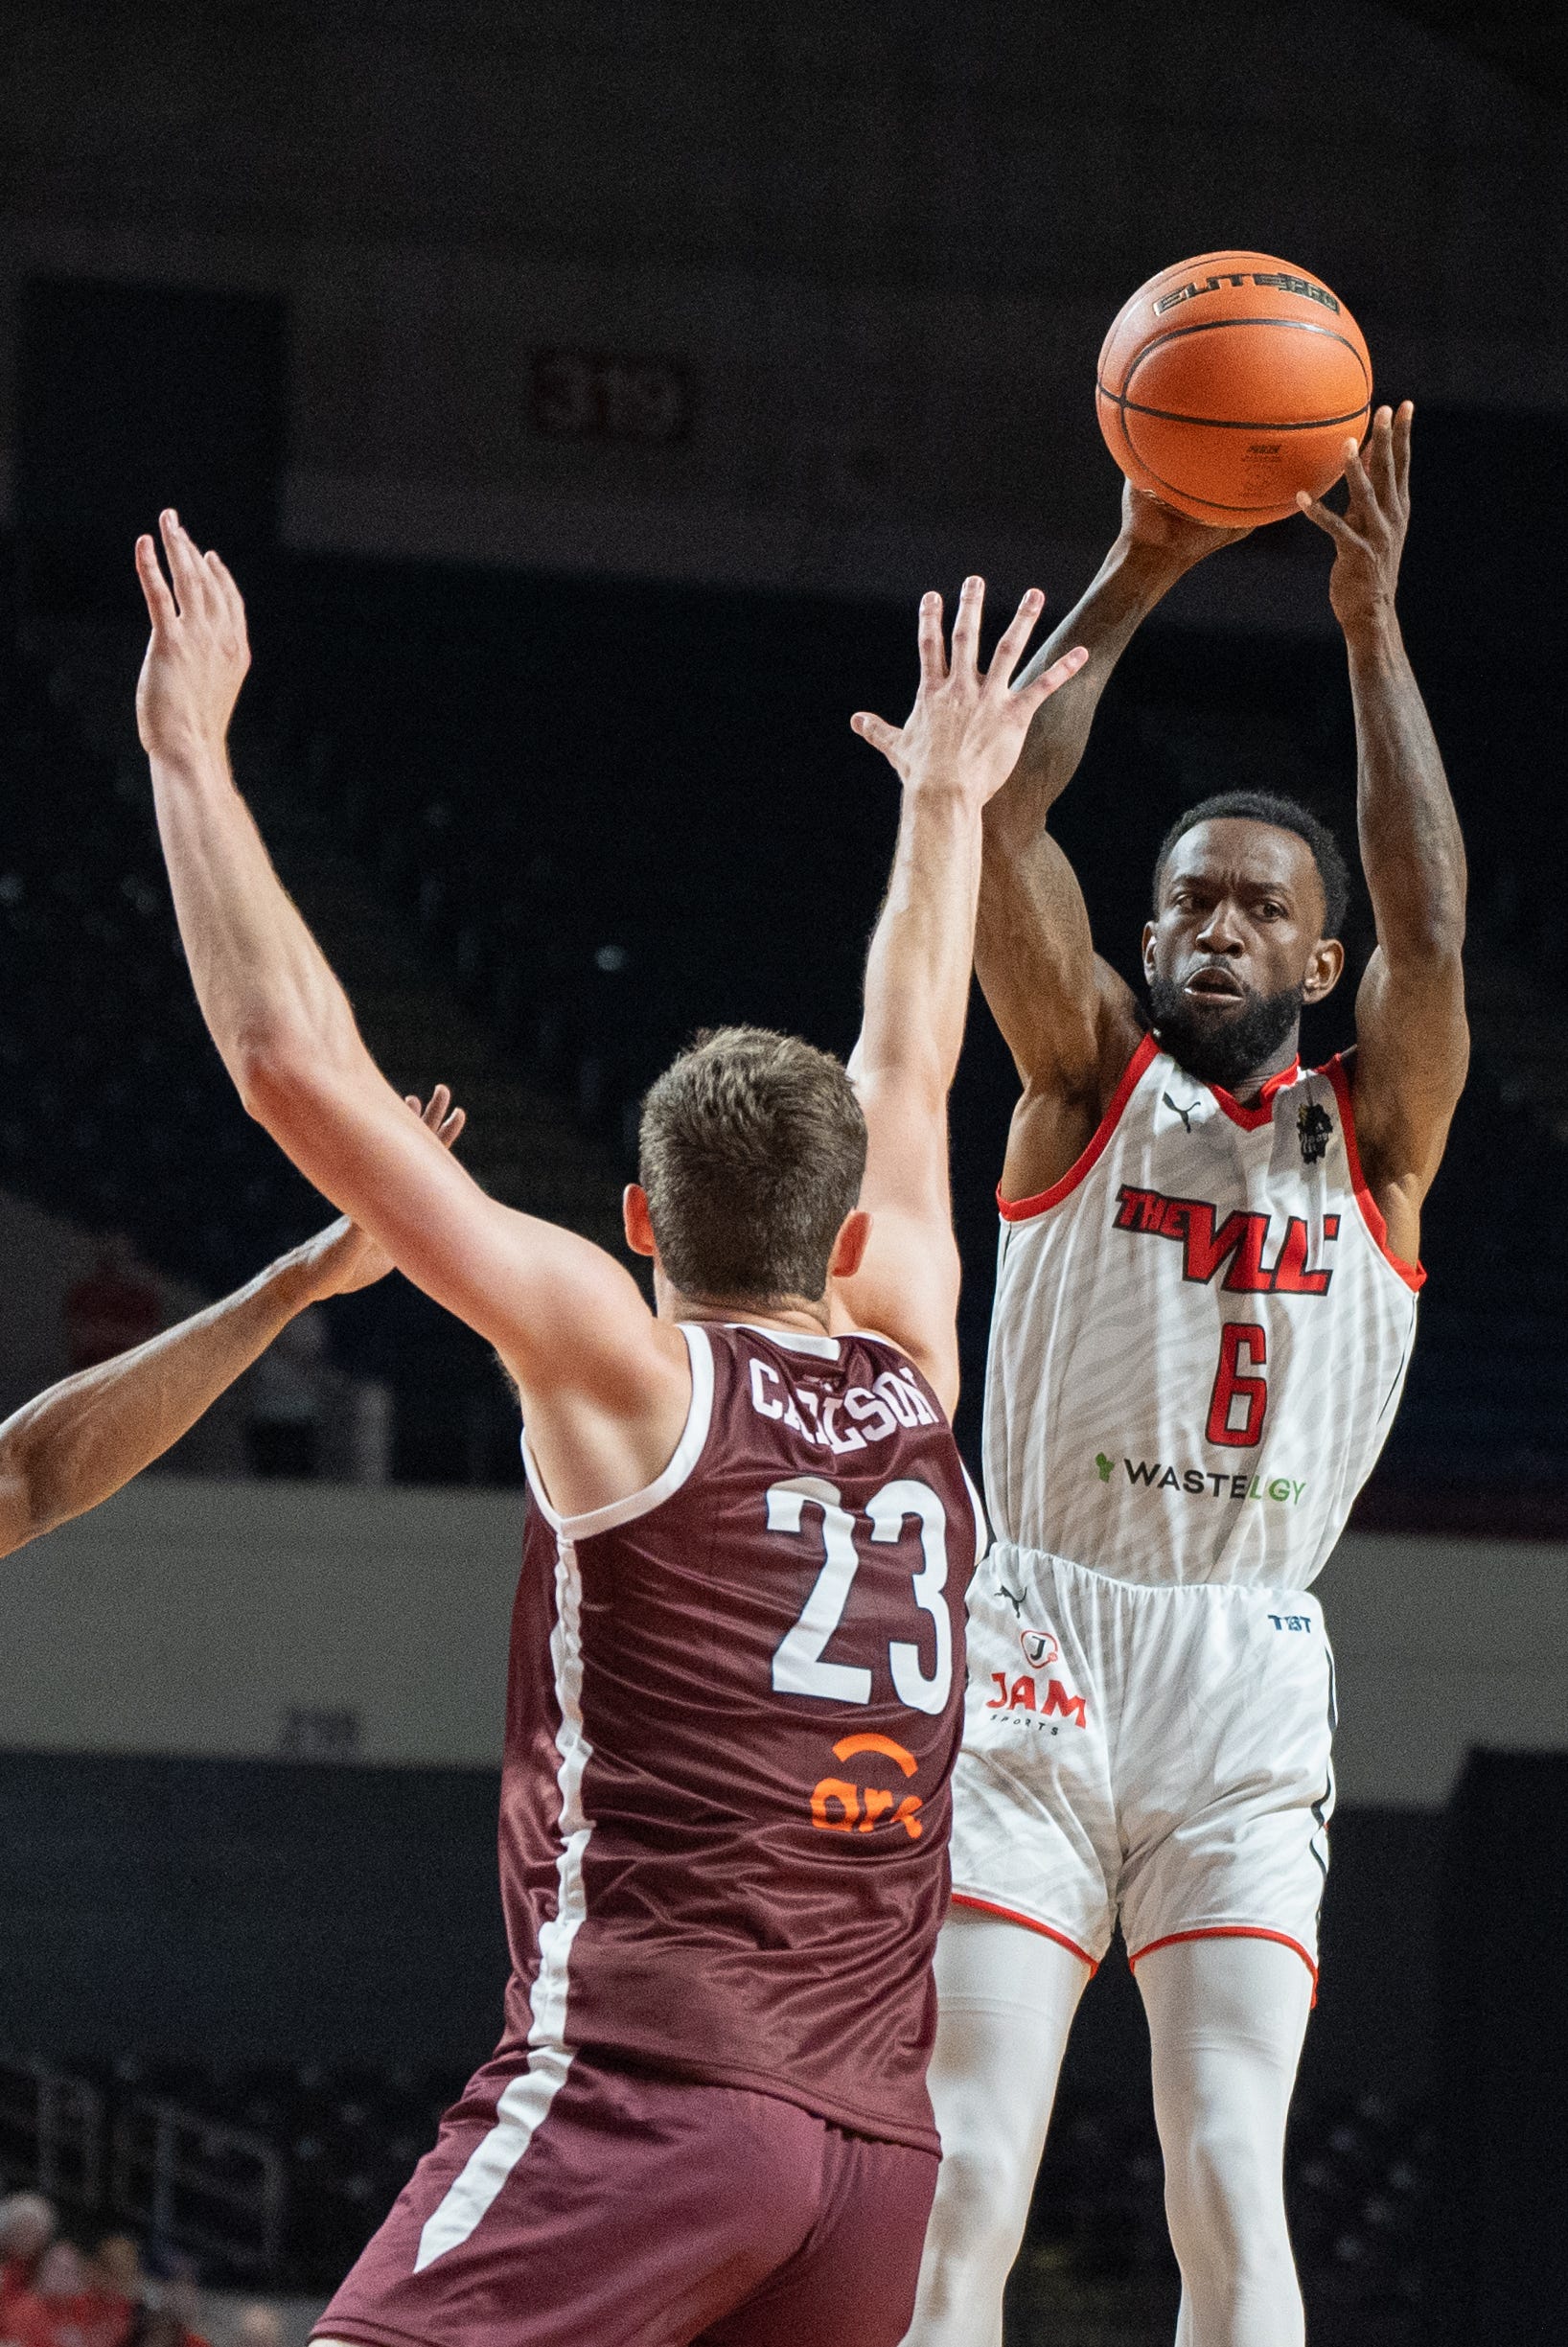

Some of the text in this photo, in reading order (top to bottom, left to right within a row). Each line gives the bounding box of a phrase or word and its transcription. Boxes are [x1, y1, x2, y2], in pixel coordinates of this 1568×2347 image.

[1113, 1185, 1187, 1241] THE
[1205, 1322, 1267, 1448] 6
[767, 1477, 952, 1714] 23
[985, 1672, 1087, 1730] JAM
[990, 1714, 1059, 1737] SPORTS
